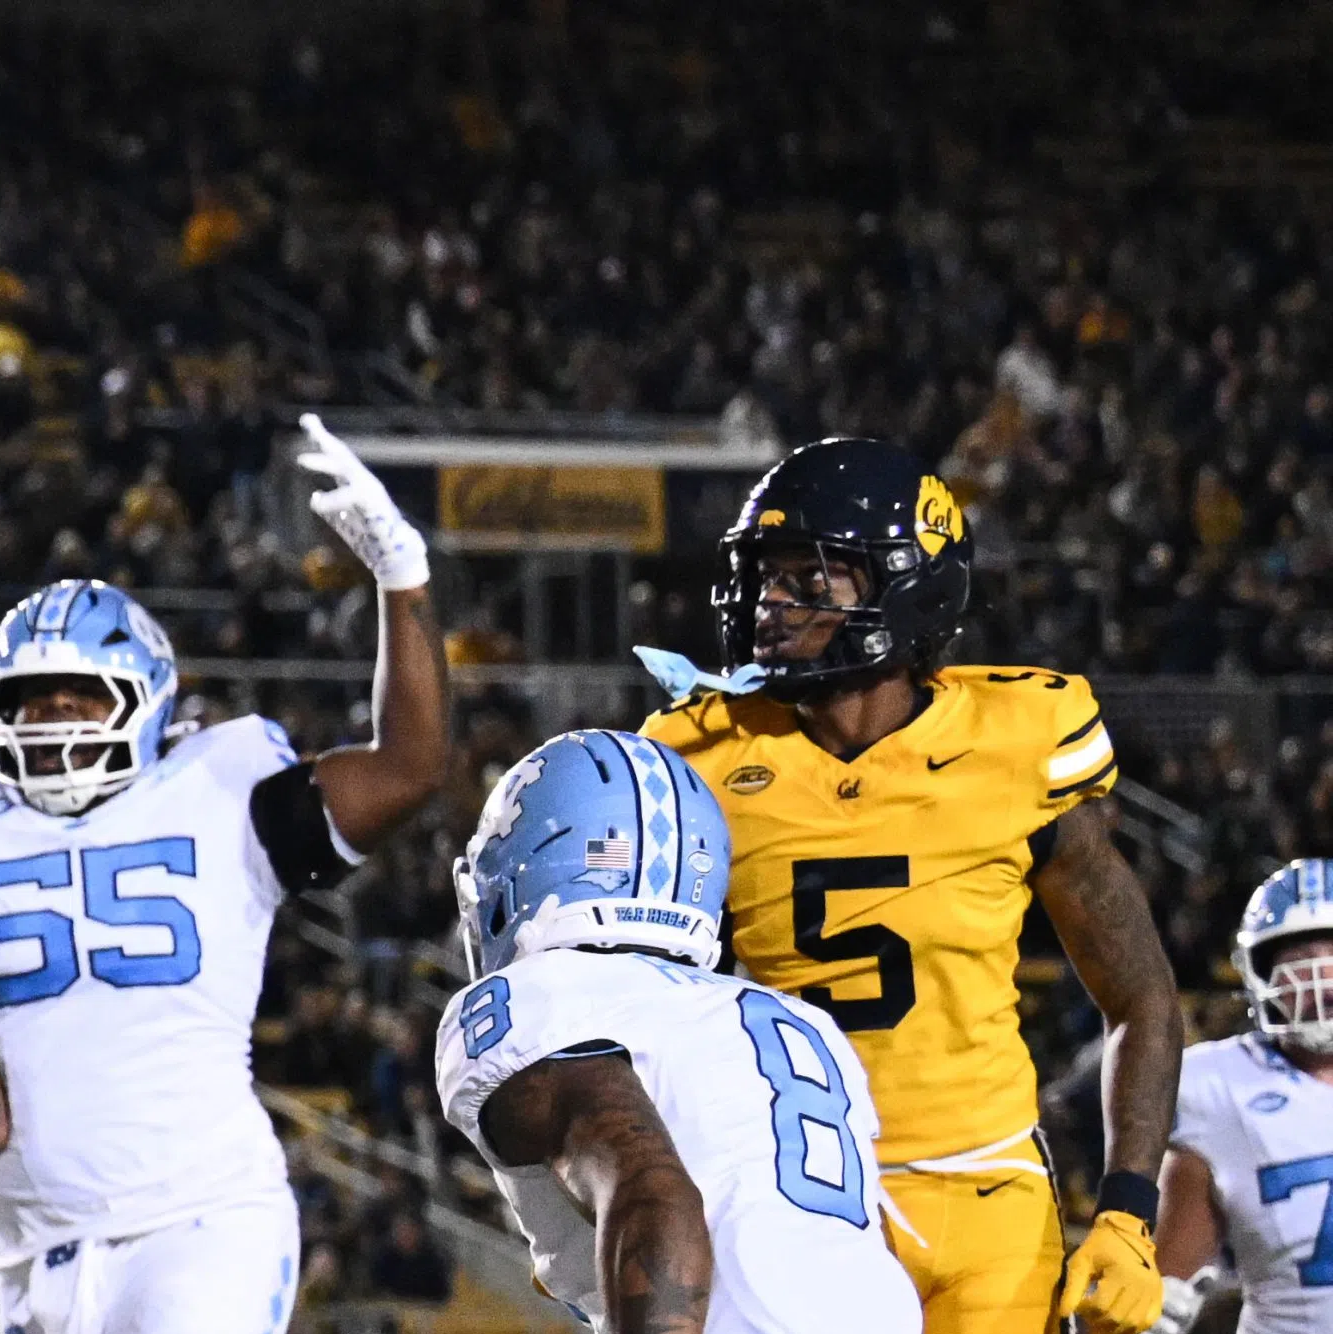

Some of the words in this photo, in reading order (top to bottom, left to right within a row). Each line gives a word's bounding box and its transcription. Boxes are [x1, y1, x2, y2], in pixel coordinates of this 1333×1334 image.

[922, 497, 953, 537] Cal
[836, 778, 861, 800] Cal
[614, 906, 644, 922] TAR
[646, 907, 691, 930] HEELS
[792, 855, 917, 1033] 5
[459, 975, 512, 1060] 8
[736, 987, 870, 1230] 8
